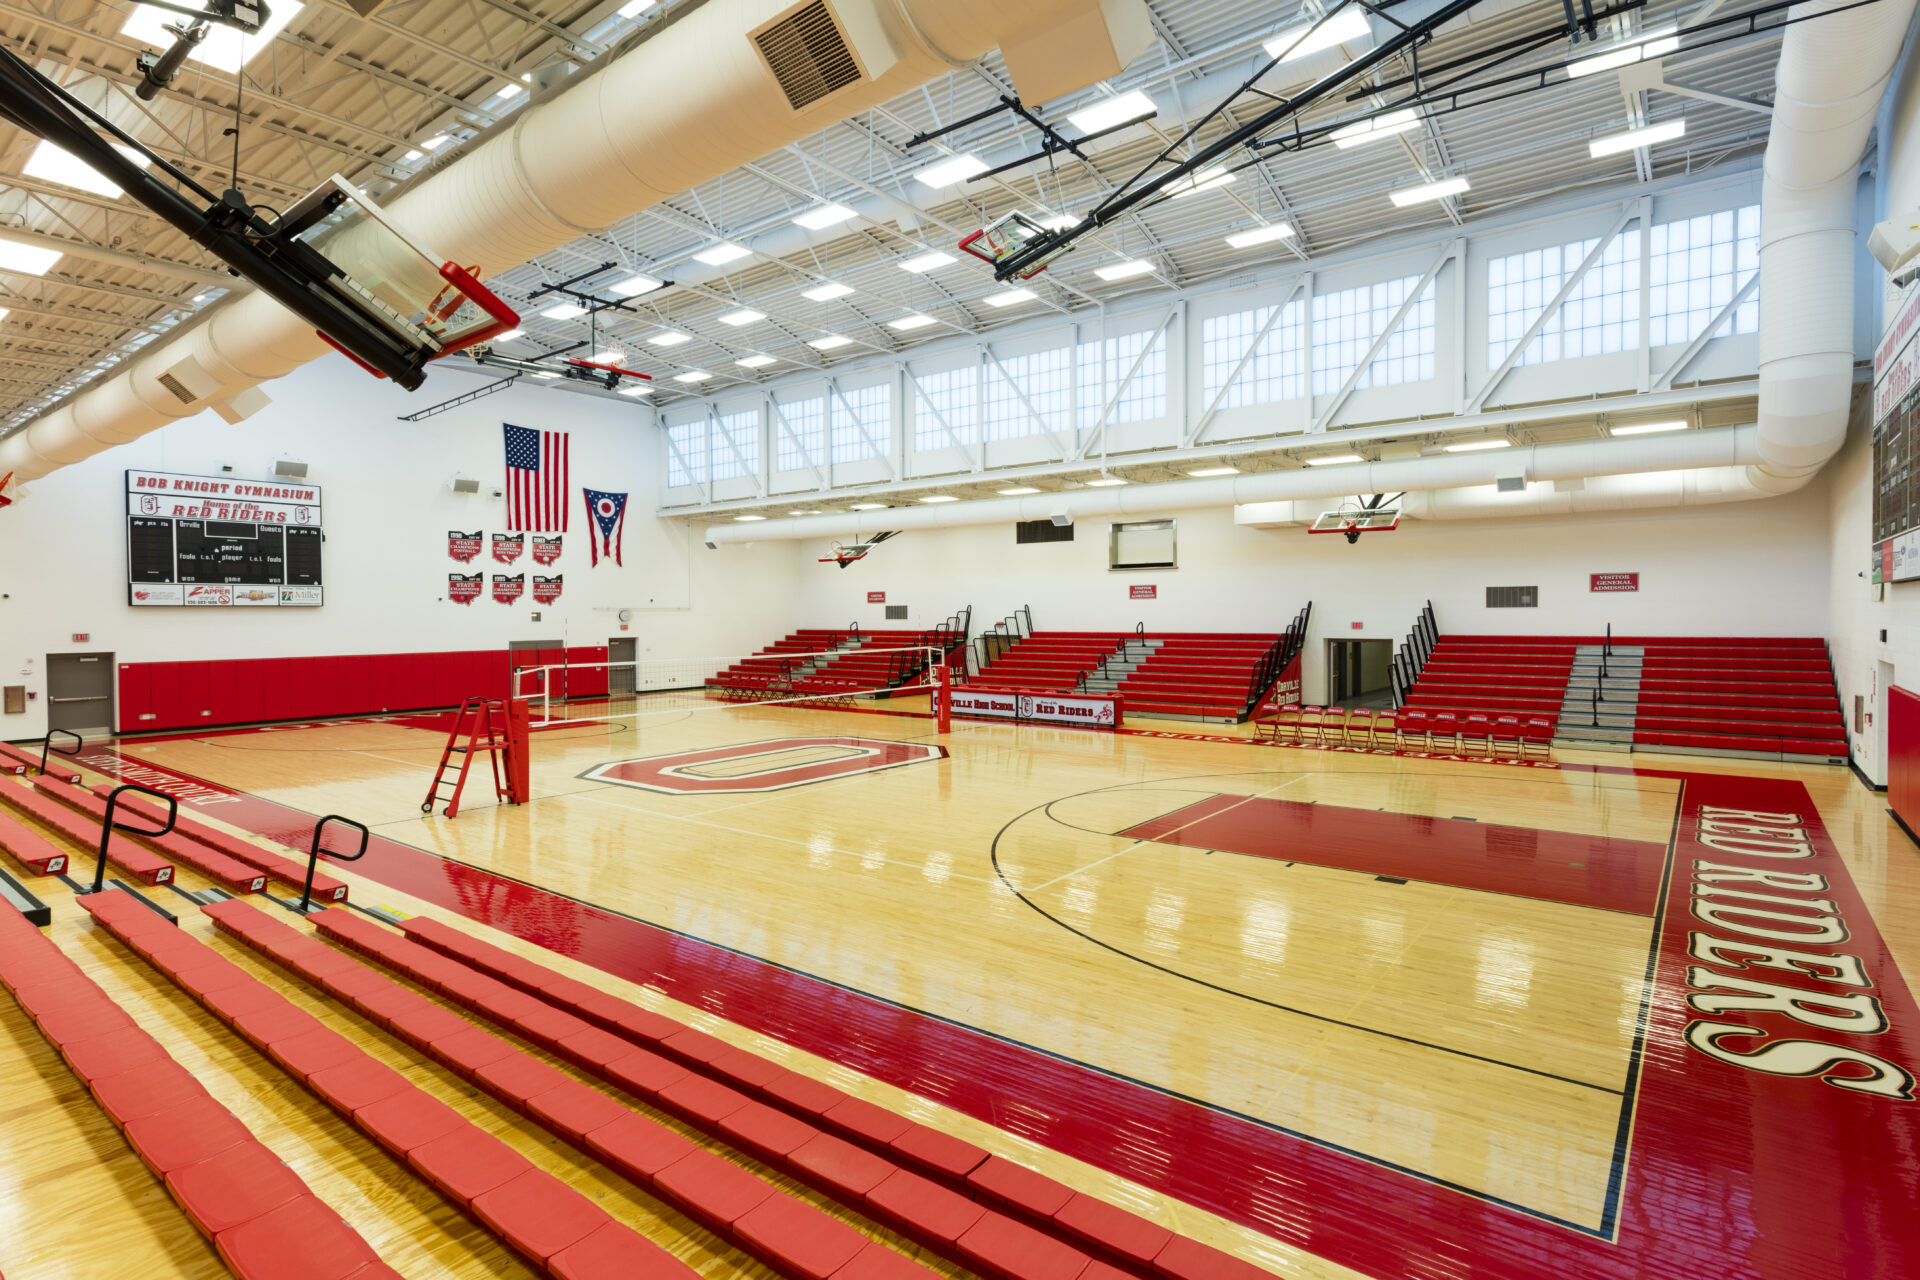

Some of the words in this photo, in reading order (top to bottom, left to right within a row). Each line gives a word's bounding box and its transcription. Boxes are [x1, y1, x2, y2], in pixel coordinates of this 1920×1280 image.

[136, 476, 168, 489] BOB
[173, 479, 229, 494] KNIGHT
[234, 484, 314, 500] GYMNASIUM
[203, 499, 231, 508] Home
[245, 502, 260, 510] the
[172, 504, 212, 518] RED
[217, 508, 287, 522] RIDERS
[221, 553, 243, 561] player
[295, 591, 320, 599] Miller
[75, 633, 89, 641] EXIT
[934, 696, 973, 708] OVILLE
[1036, 703, 1055, 714] RED
[1058, 705, 1094, 717] RIDERS
[155, 782, 243, 806] COURT
[1695, 804, 1818, 859] RED
[1681, 859, 1917, 1101] RIDERS
